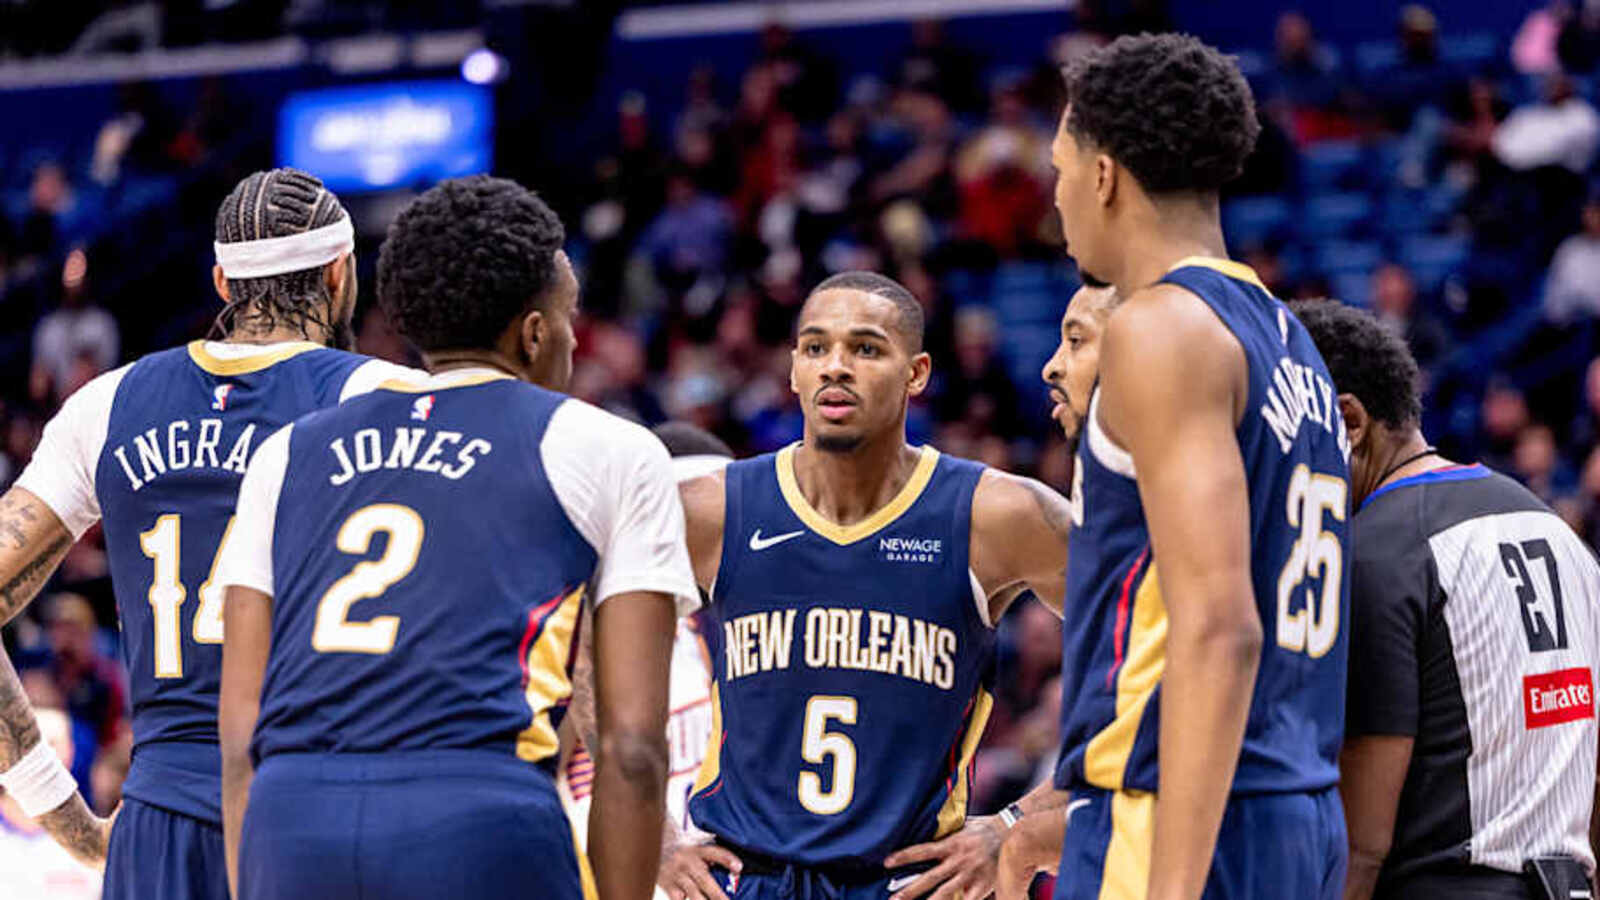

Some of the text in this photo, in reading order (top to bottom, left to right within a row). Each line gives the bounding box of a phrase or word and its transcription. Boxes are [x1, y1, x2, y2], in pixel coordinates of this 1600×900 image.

[114, 418, 256, 491] INGRA
[330, 427, 492, 486] JONES
[312, 502, 425, 655] 2
[886, 552, 935, 562] GARAGE
[1276, 462, 1348, 660] 25
[1498, 537, 1569, 653] 27
[724, 606, 958, 690] NEW ORLEANS
[797, 694, 858, 815] 5
